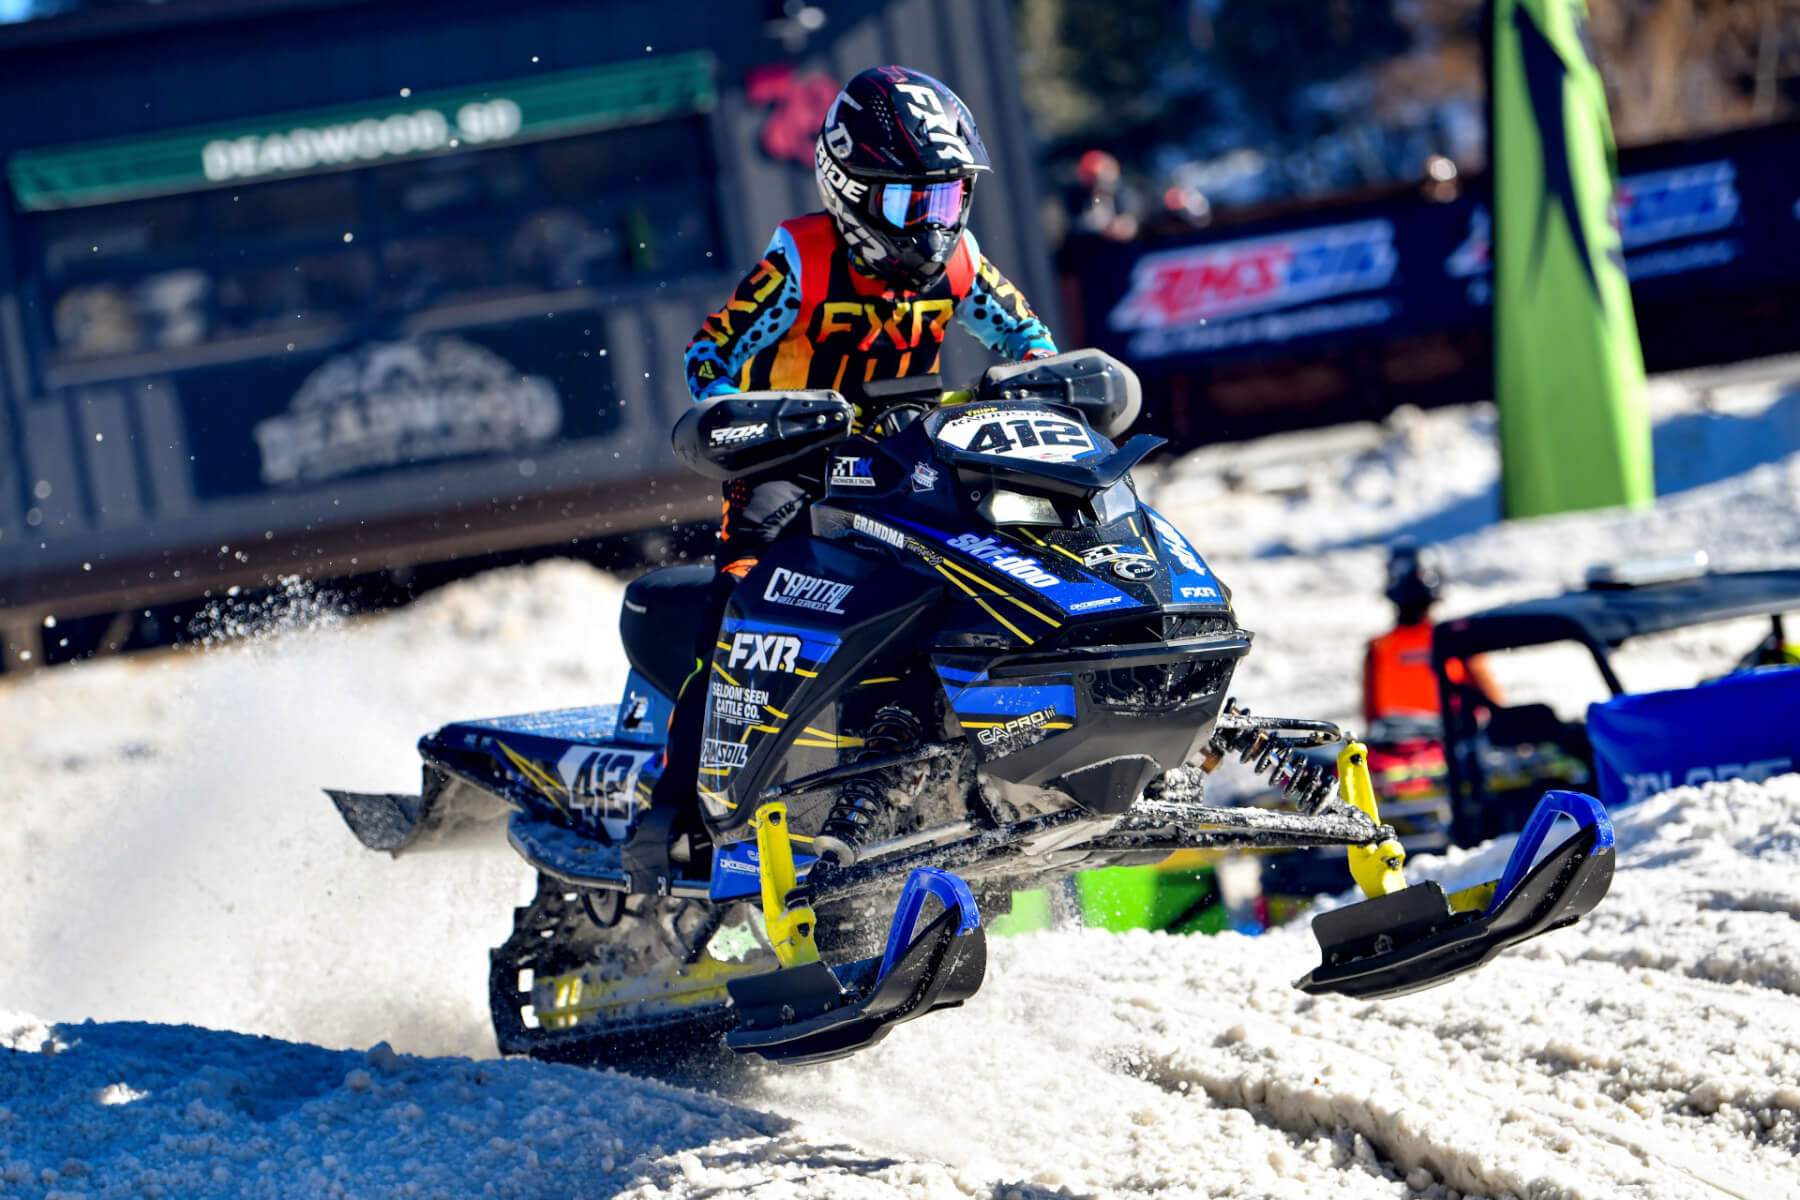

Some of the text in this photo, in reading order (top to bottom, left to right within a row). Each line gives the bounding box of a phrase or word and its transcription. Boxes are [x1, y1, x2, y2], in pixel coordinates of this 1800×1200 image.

[893, 83, 975, 164] FXR
[815, 298, 954, 351] FXR
[966, 419, 1092, 454] 412
[853, 514, 905, 550] GRANDMA
[763, 567, 854, 615] CAPITAL
[795, 598, 828, 611] SERVICES
[1180, 587, 1217, 598] FXR
[728, 633, 801, 673] FXR
[712, 682, 769, 705] SELDOM SEEN
[716, 699, 760, 719] CATTLE CO.
[701, 739, 748, 768] AMSOIL
